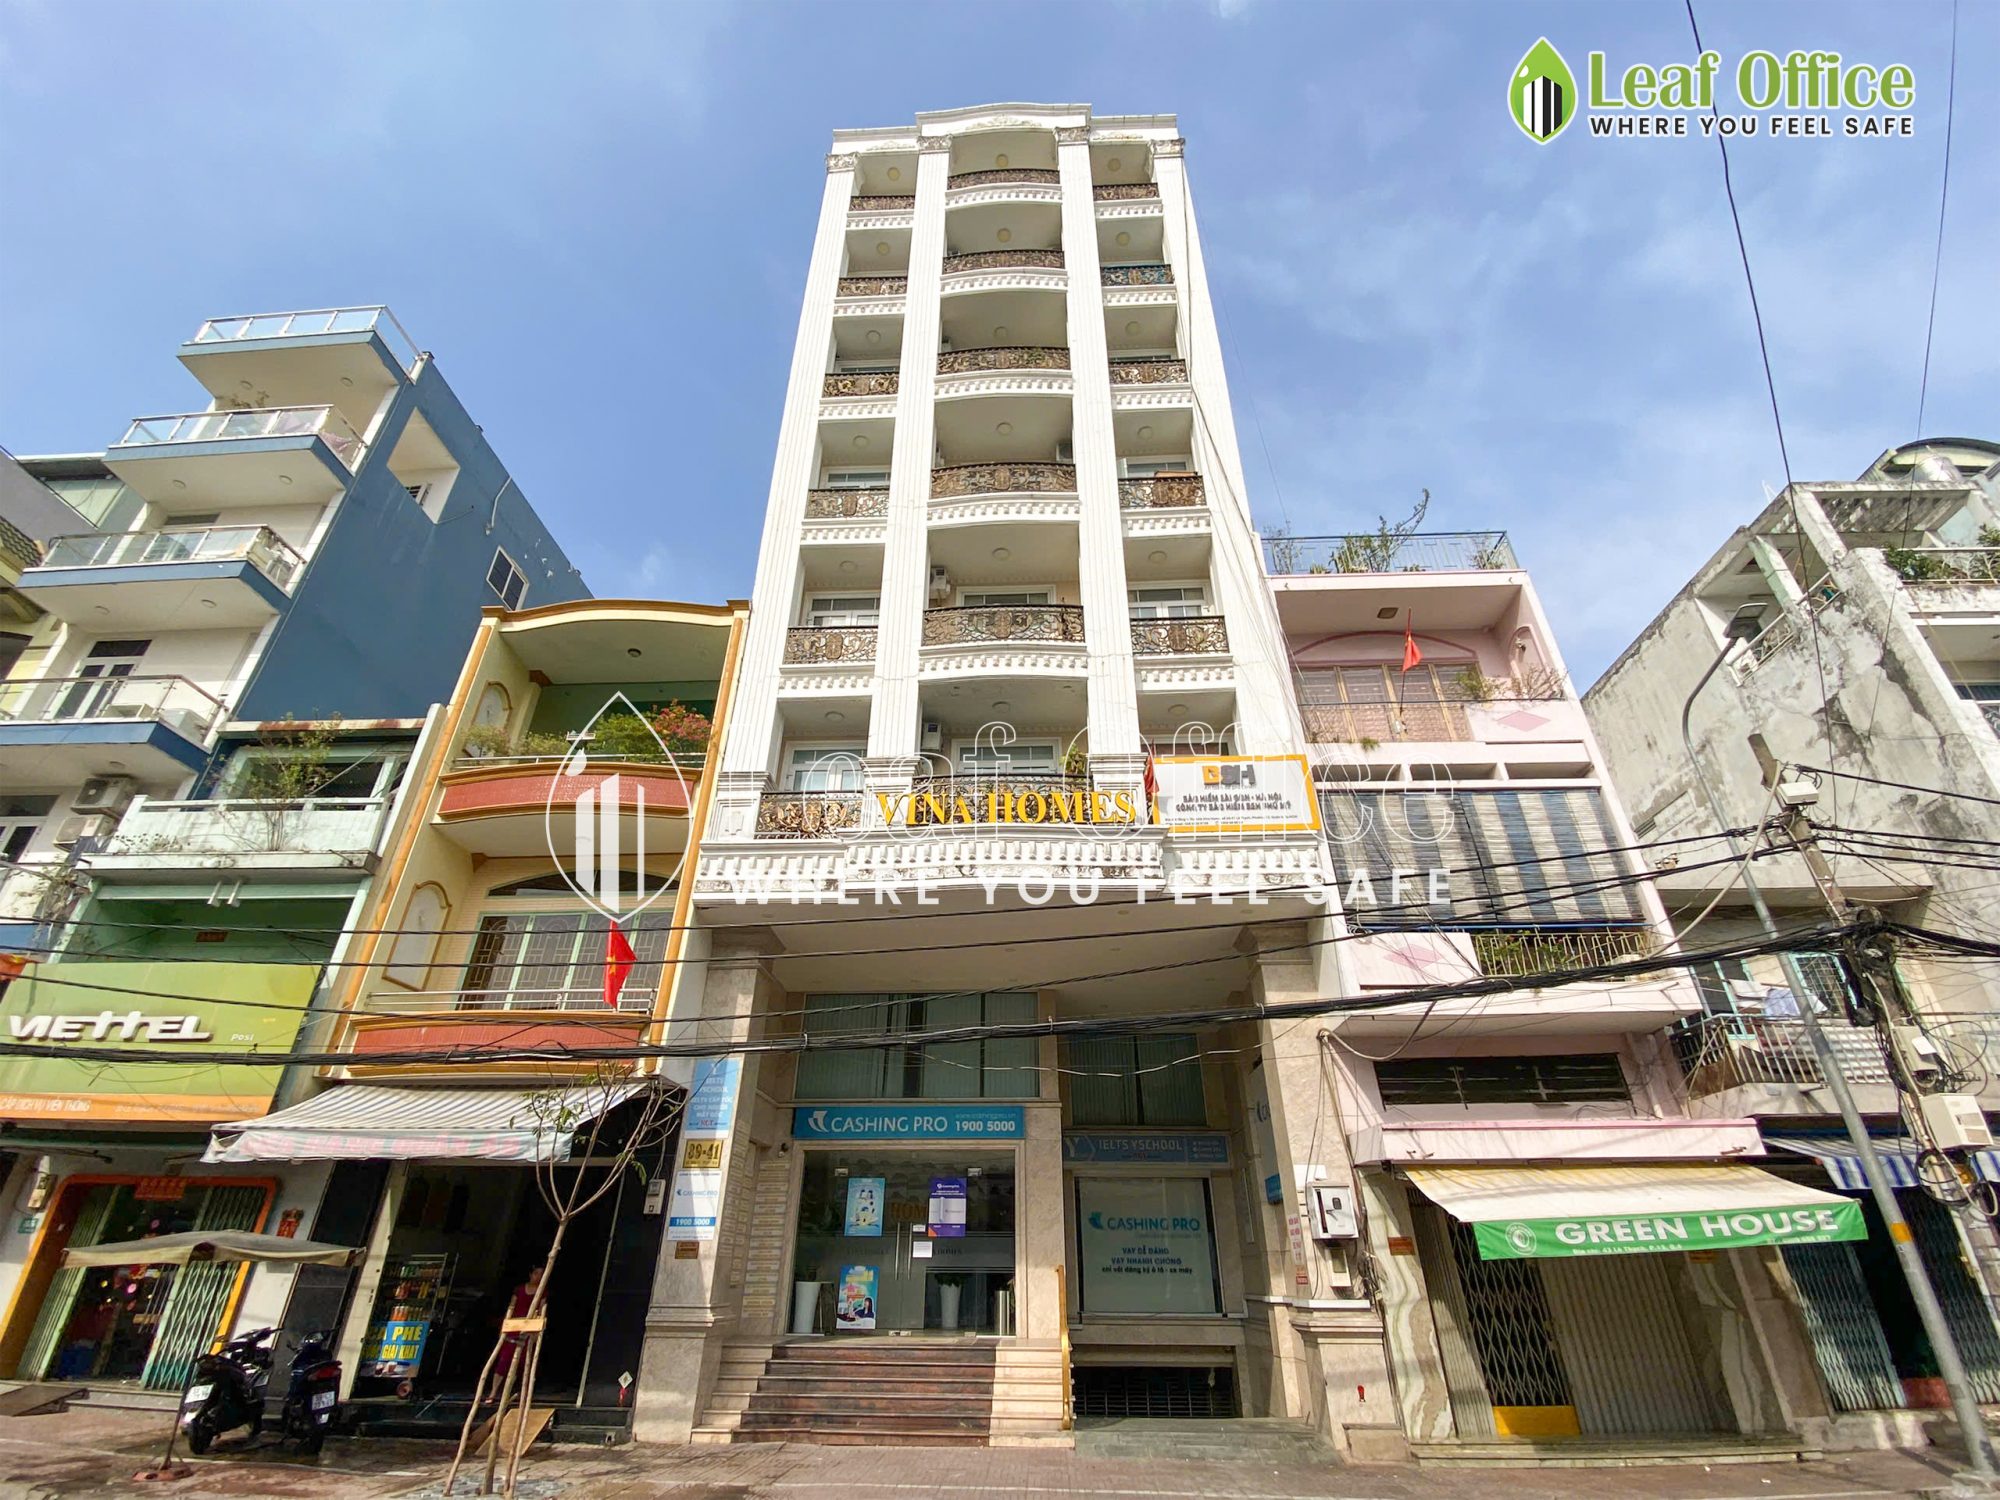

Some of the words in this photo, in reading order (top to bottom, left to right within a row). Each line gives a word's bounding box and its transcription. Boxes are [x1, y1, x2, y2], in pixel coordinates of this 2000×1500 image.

[876, 791, 974, 826] VINA
[988, 790, 1137, 825] HOMES
[831, 1116, 909, 1133] CASHING
[913, 1116, 948, 1132] PRO
[955, 1120, 983, 1132] 1900
[986, 1120, 1016, 1132] 5000
[1099, 1139, 1129, 1150] IELTS
[1107, 1217, 1169, 1231] CASHING
[1172, 1217, 1201, 1231] PRO
[1554, 1216, 1689, 1245] GREEN
[1699, 1209, 1840, 1239] HOUSE
